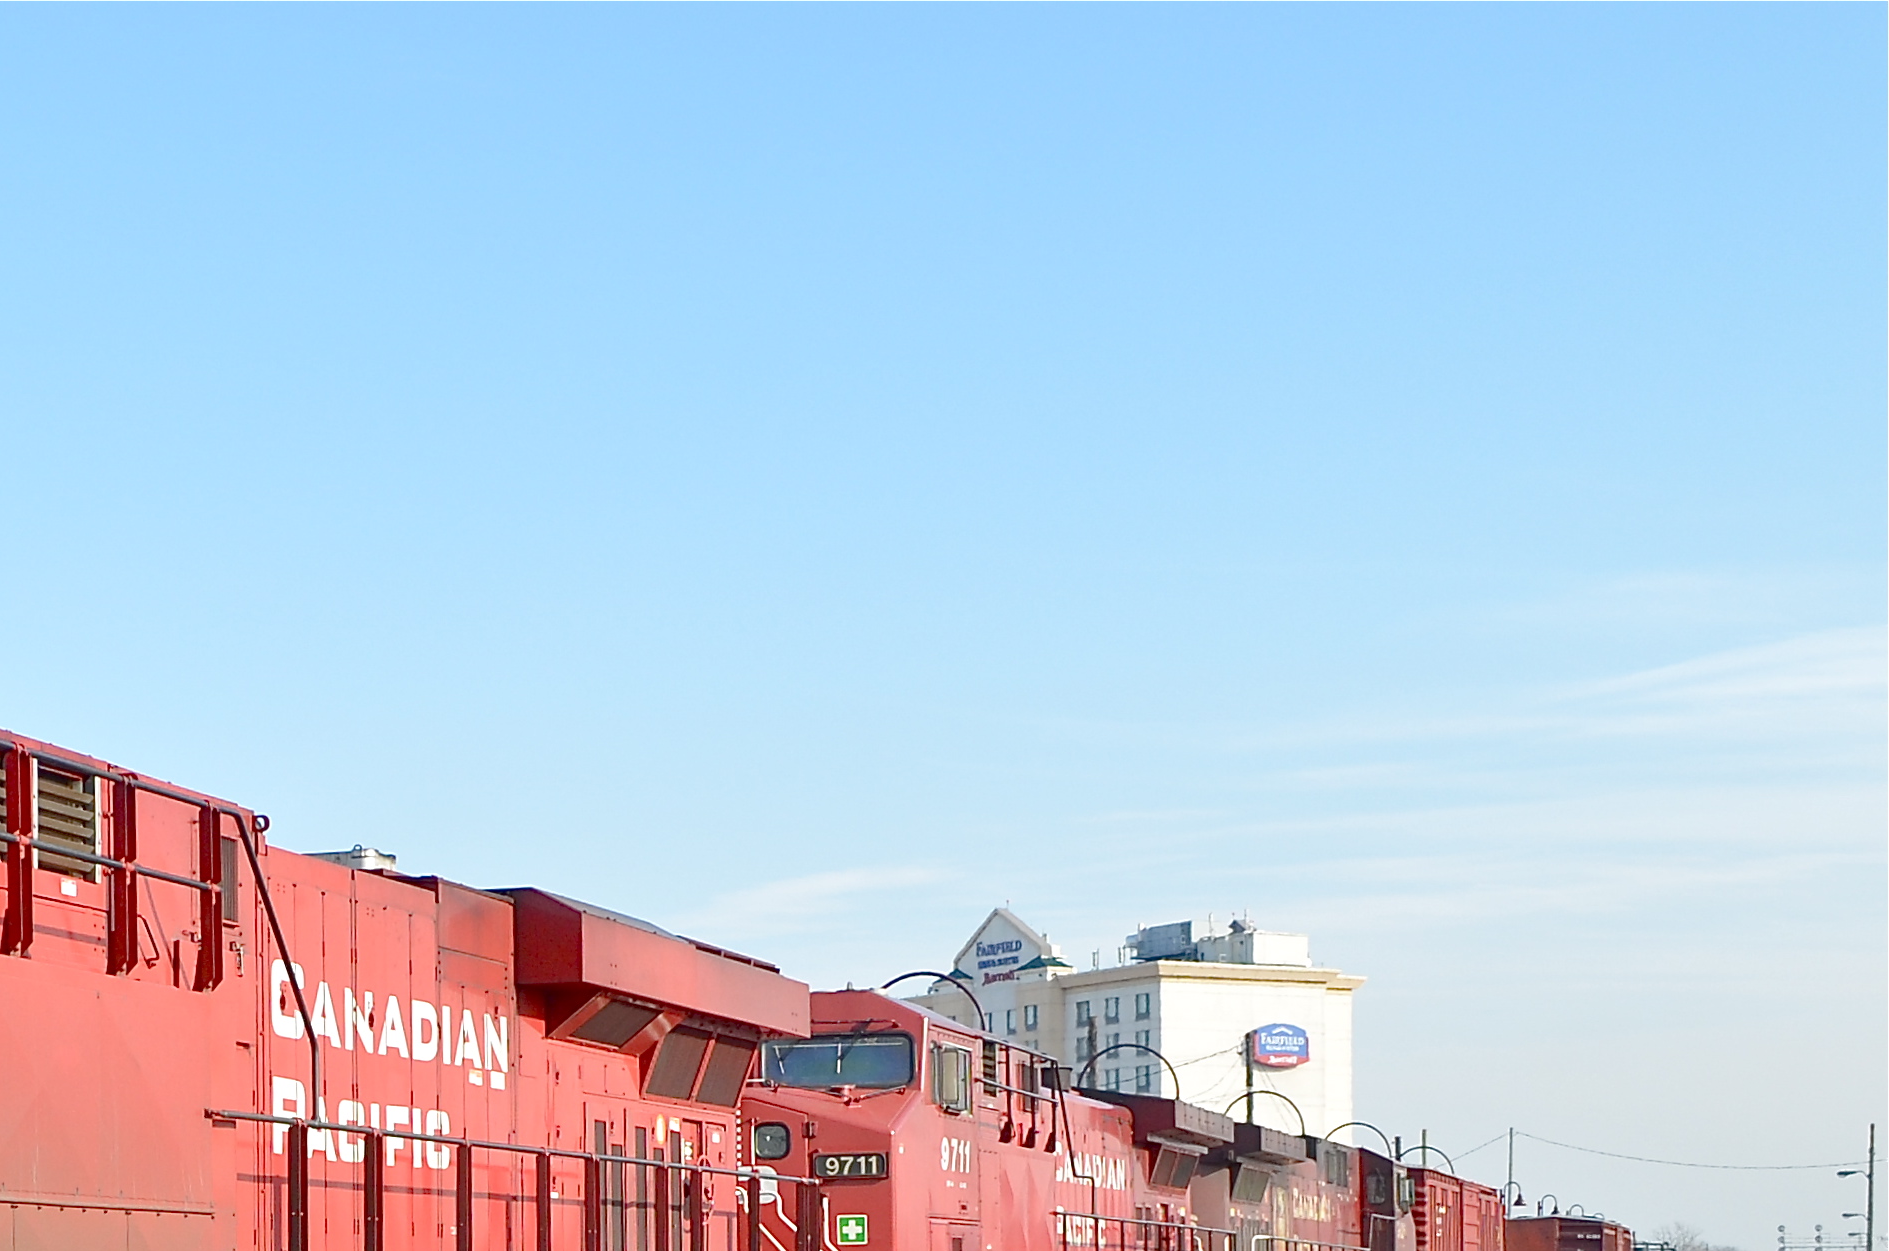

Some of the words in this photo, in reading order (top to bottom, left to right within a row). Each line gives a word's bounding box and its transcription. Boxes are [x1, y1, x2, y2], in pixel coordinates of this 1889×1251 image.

[976, 940, 1022, 957] FAIRFIELD
[271, 958, 509, 1074] CANADIAN
[272, 1075, 451, 1170] PACIFIC
[825, 1155, 878, 1176] 9711
[941, 1136, 970, 1173] 9711
[1054, 1140, 1126, 1191] CANADIAN
[1056, 1205, 1106, 1249] PACIFC
